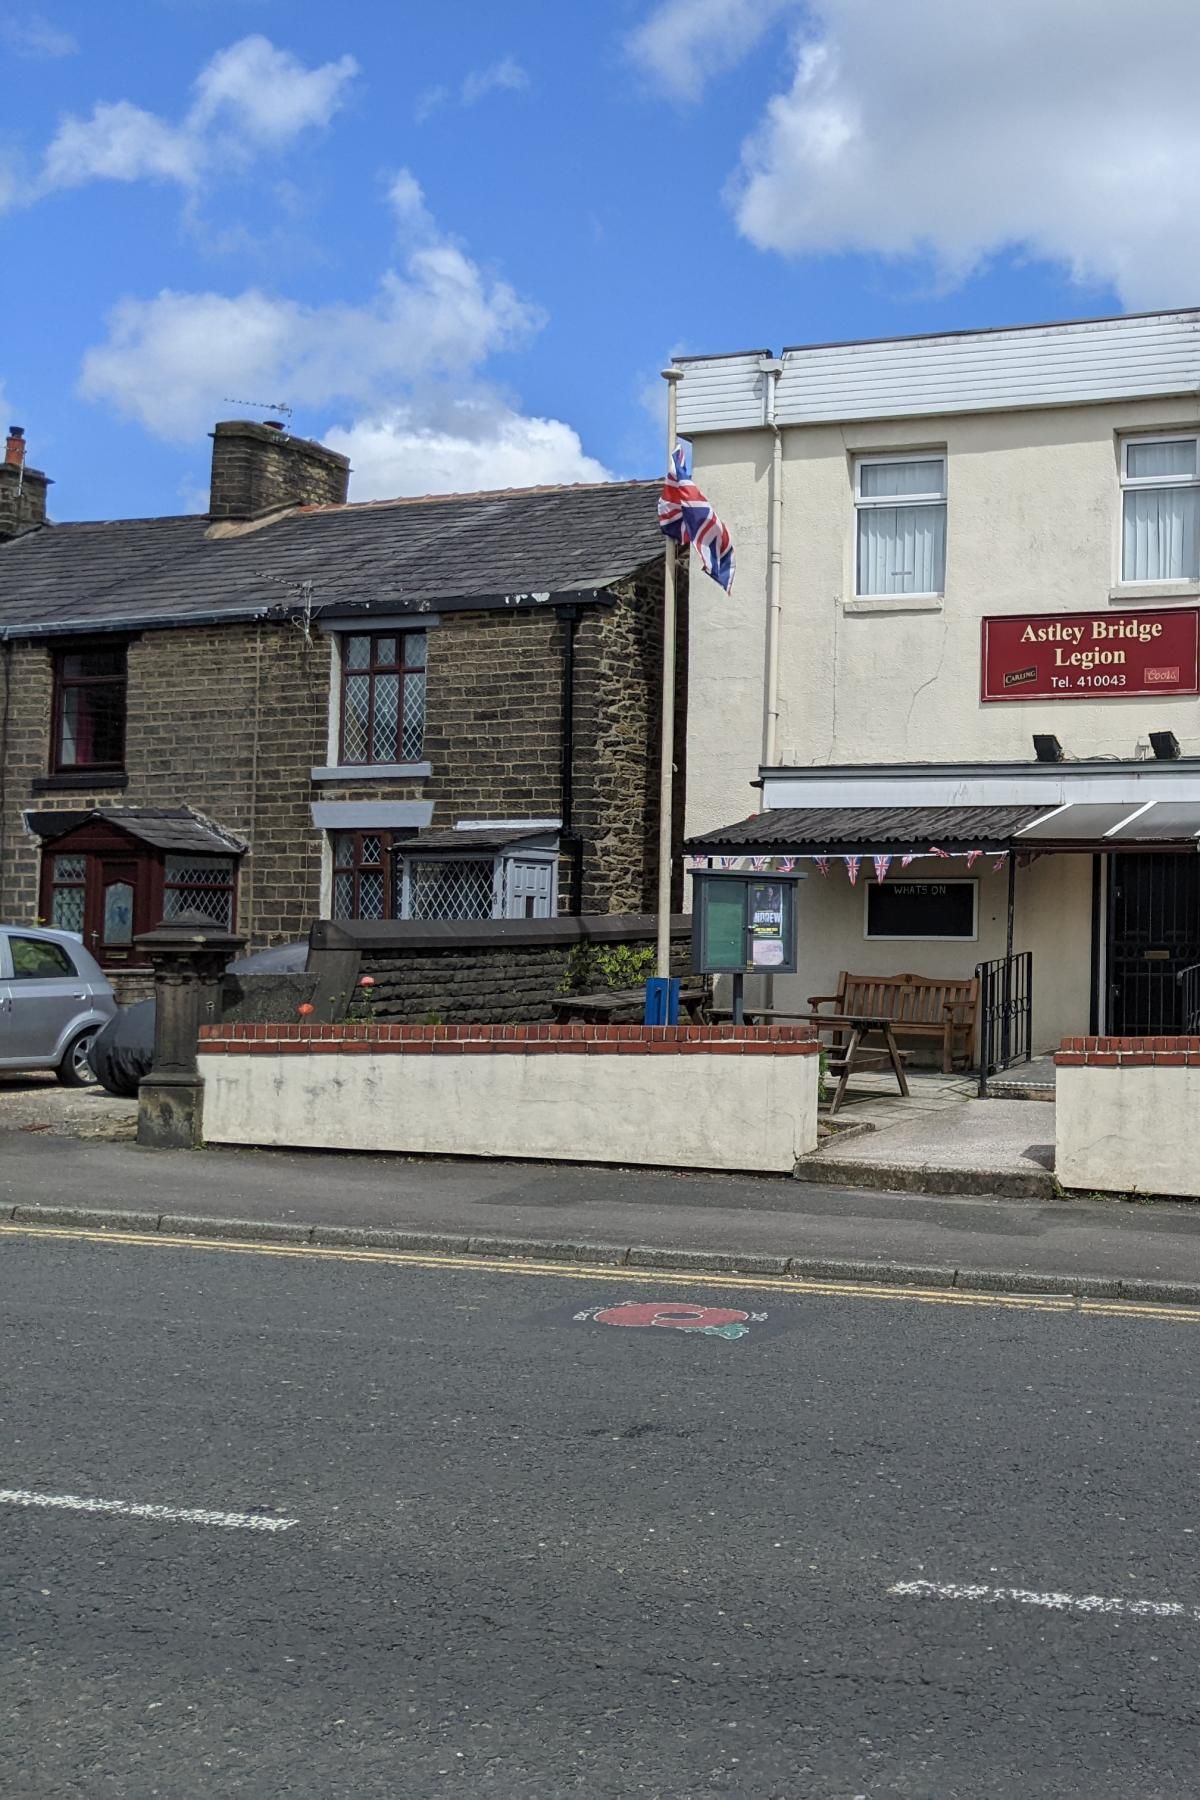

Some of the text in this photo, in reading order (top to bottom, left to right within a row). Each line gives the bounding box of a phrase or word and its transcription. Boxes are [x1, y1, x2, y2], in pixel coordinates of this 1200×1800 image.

[1021, 620, 1162, 644] Astley Bridge
[1055, 647, 1126, 669] Legion
[1005, 671, 1036, 684] CARLING
[1051, 675, 1127, 688] Tel. 410043
[931, 885, 946, 896] ON
